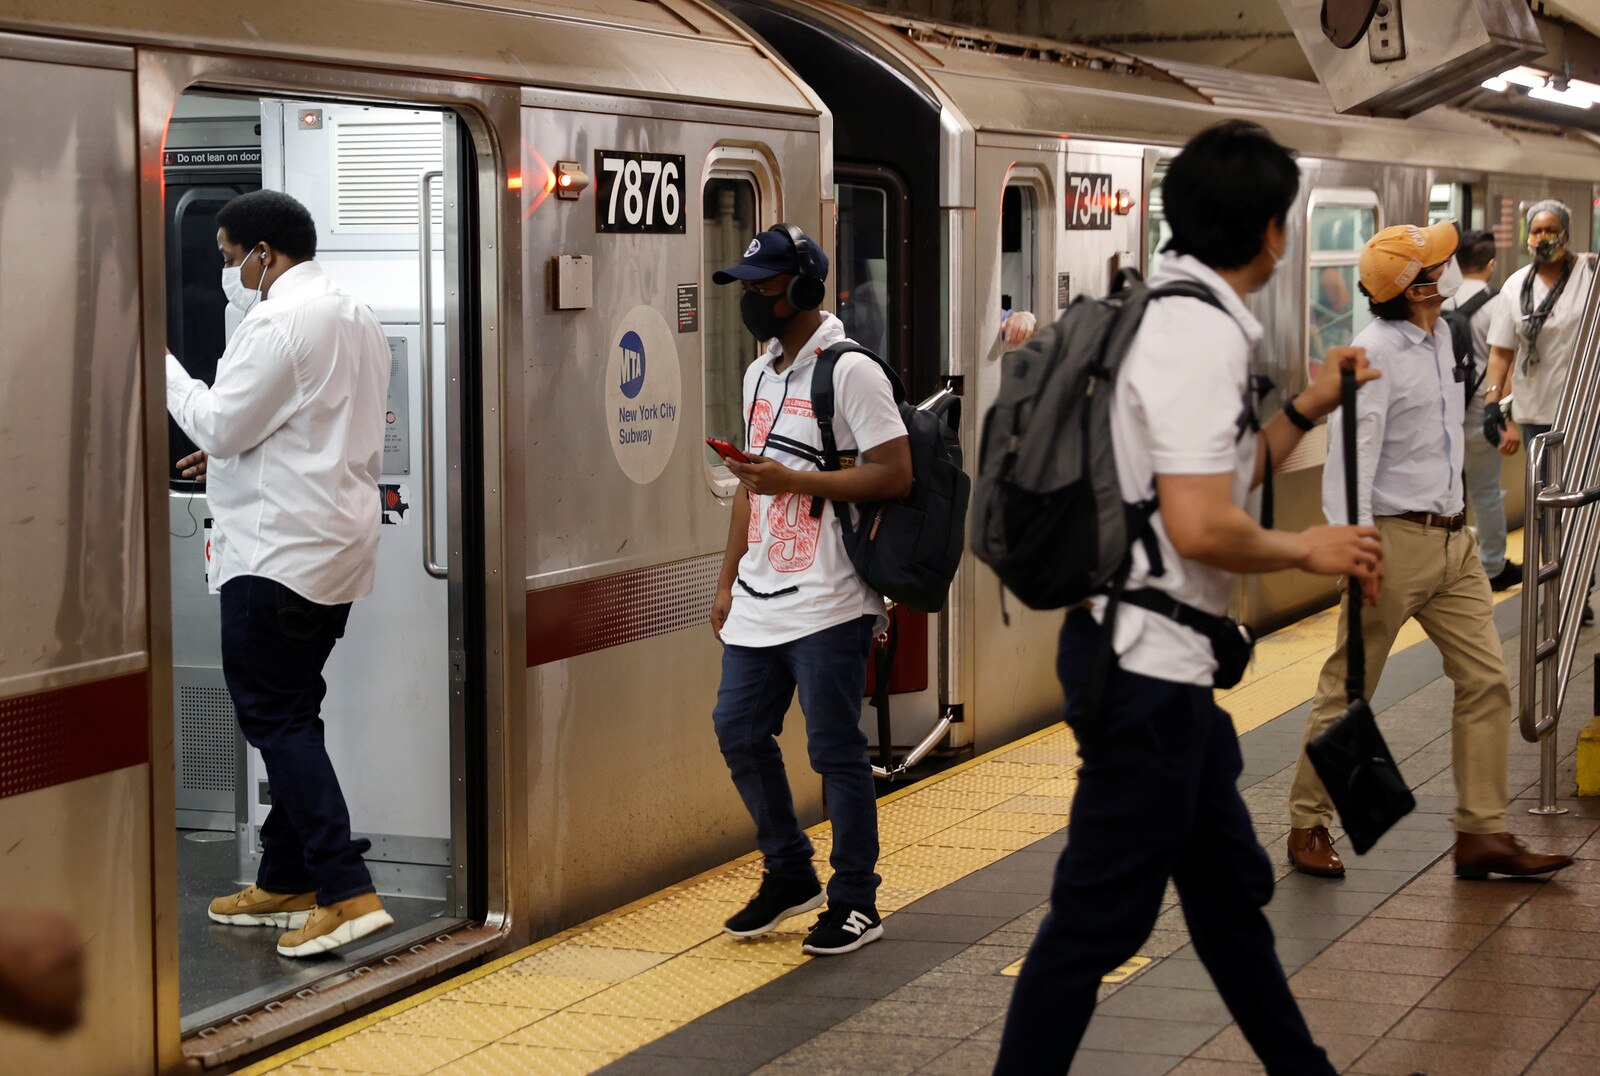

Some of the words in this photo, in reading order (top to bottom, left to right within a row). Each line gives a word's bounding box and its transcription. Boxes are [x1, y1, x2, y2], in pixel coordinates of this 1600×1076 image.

[177, 153, 190, 163] Do
[191, 153, 206, 163] not
[207, 152, 226, 162] lean
[226, 154, 239, 162] on
[240, 152, 261, 161] door
[603, 158, 680, 226] 7876
[1070, 176, 1109, 226] 7341
[619, 346, 642, 386] MTA
[618, 407, 638, 423] New
[639, 405, 659, 421] York
[660, 402, 676, 421] City
[619, 427, 653, 445] Subway
